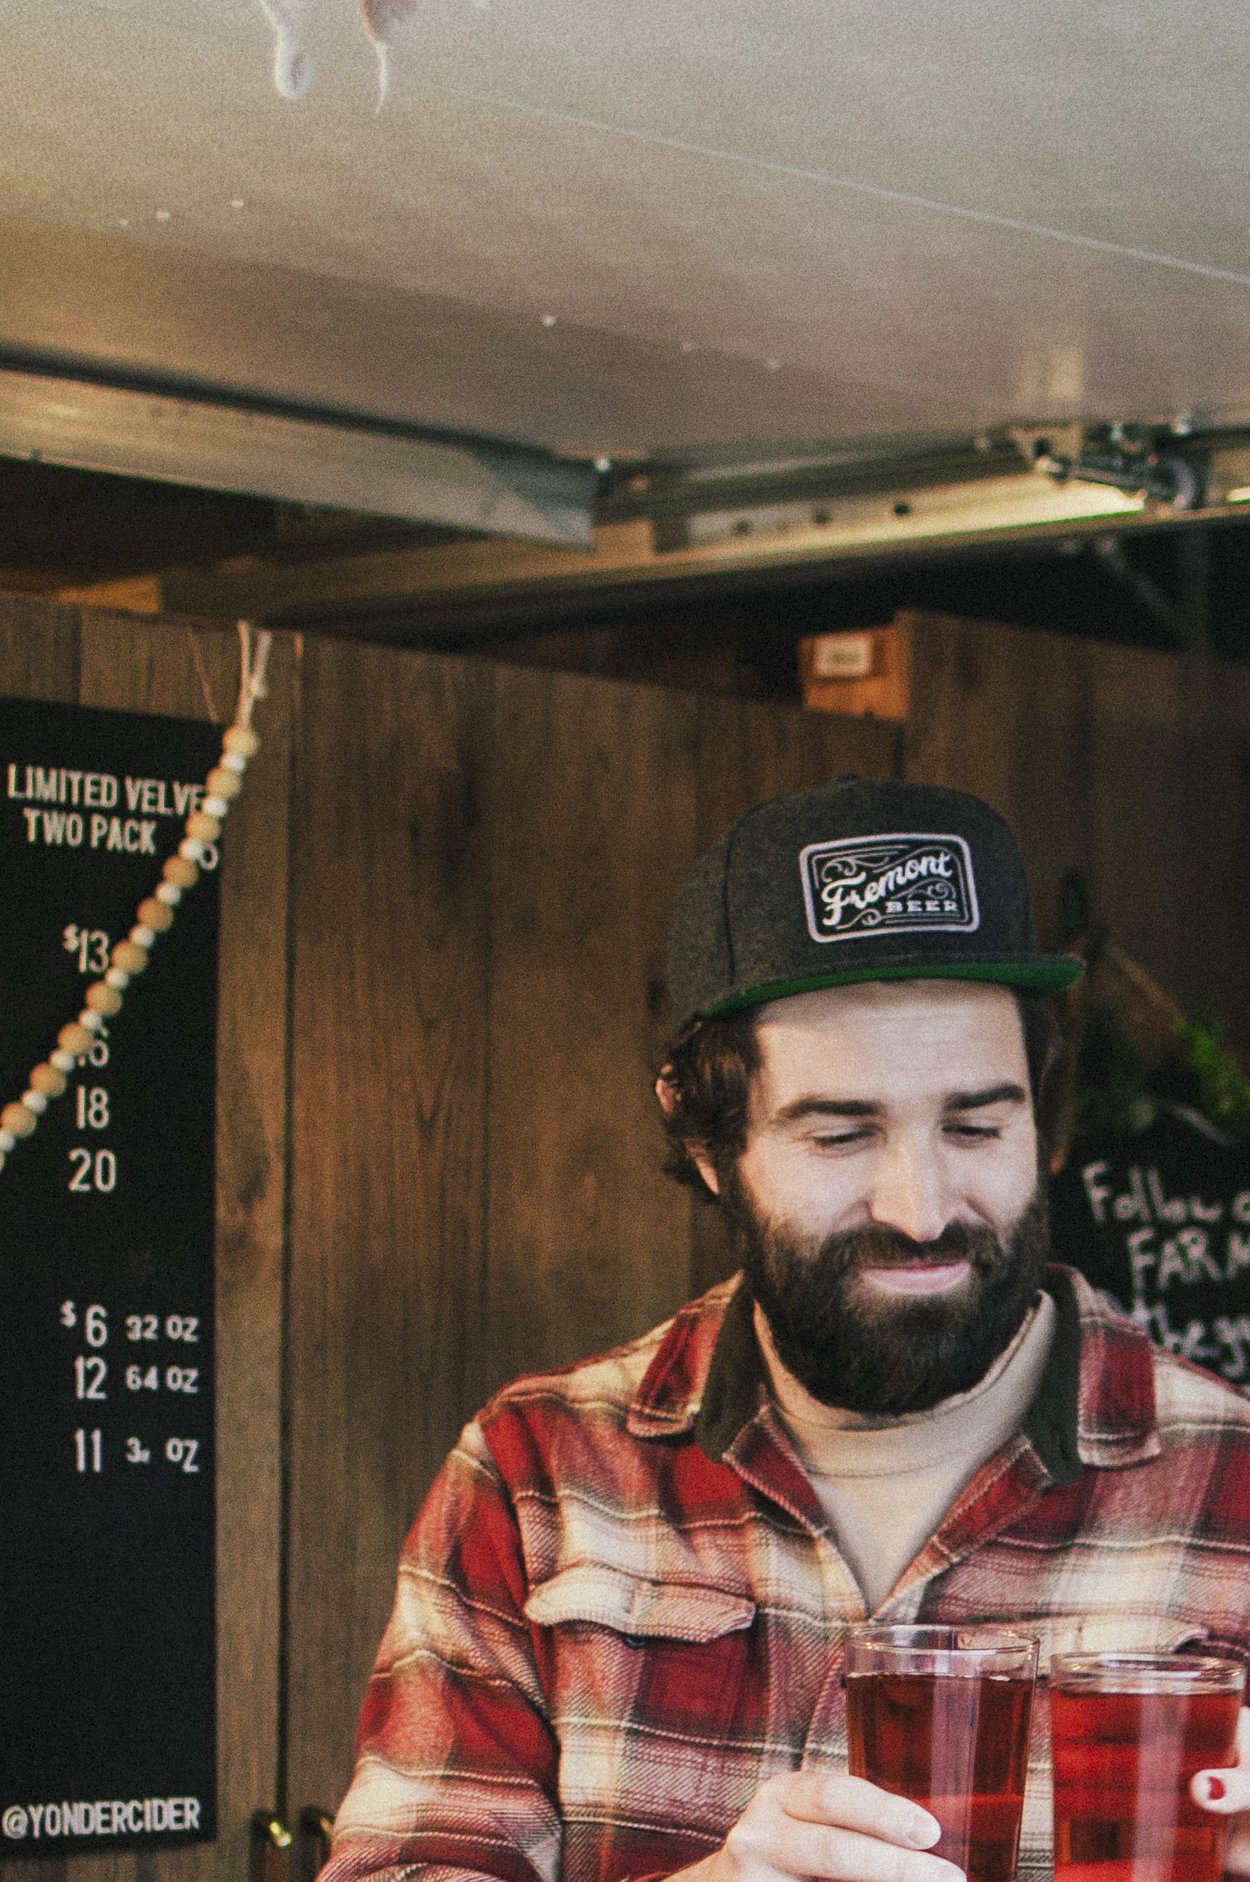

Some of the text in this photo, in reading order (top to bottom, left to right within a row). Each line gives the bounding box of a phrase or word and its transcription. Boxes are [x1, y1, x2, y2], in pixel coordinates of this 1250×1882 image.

[7, 763, 207, 816] LIMITED VELVE
[23, 807, 157, 855] TWO PACK
[821, 851, 953, 926] Fremont
[886, 900, 959, 914] BEER
[62, 923, 110, 973] $13
[76, 1085, 110, 1129] 18
[68, 1148, 117, 1192] 20
[1082, 1160, 1222, 1222] Follow
[125, 1314, 158, 1341] 32
[165, 1315, 199, 1342] OZ
[75, 1355, 199, 1400] 12 64 OZ
[75, 1428, 102, 1473] 11
[165, 1438, 199, 1472] OZ
[2, 1797, 201, 1839] @YONDERCIDER
